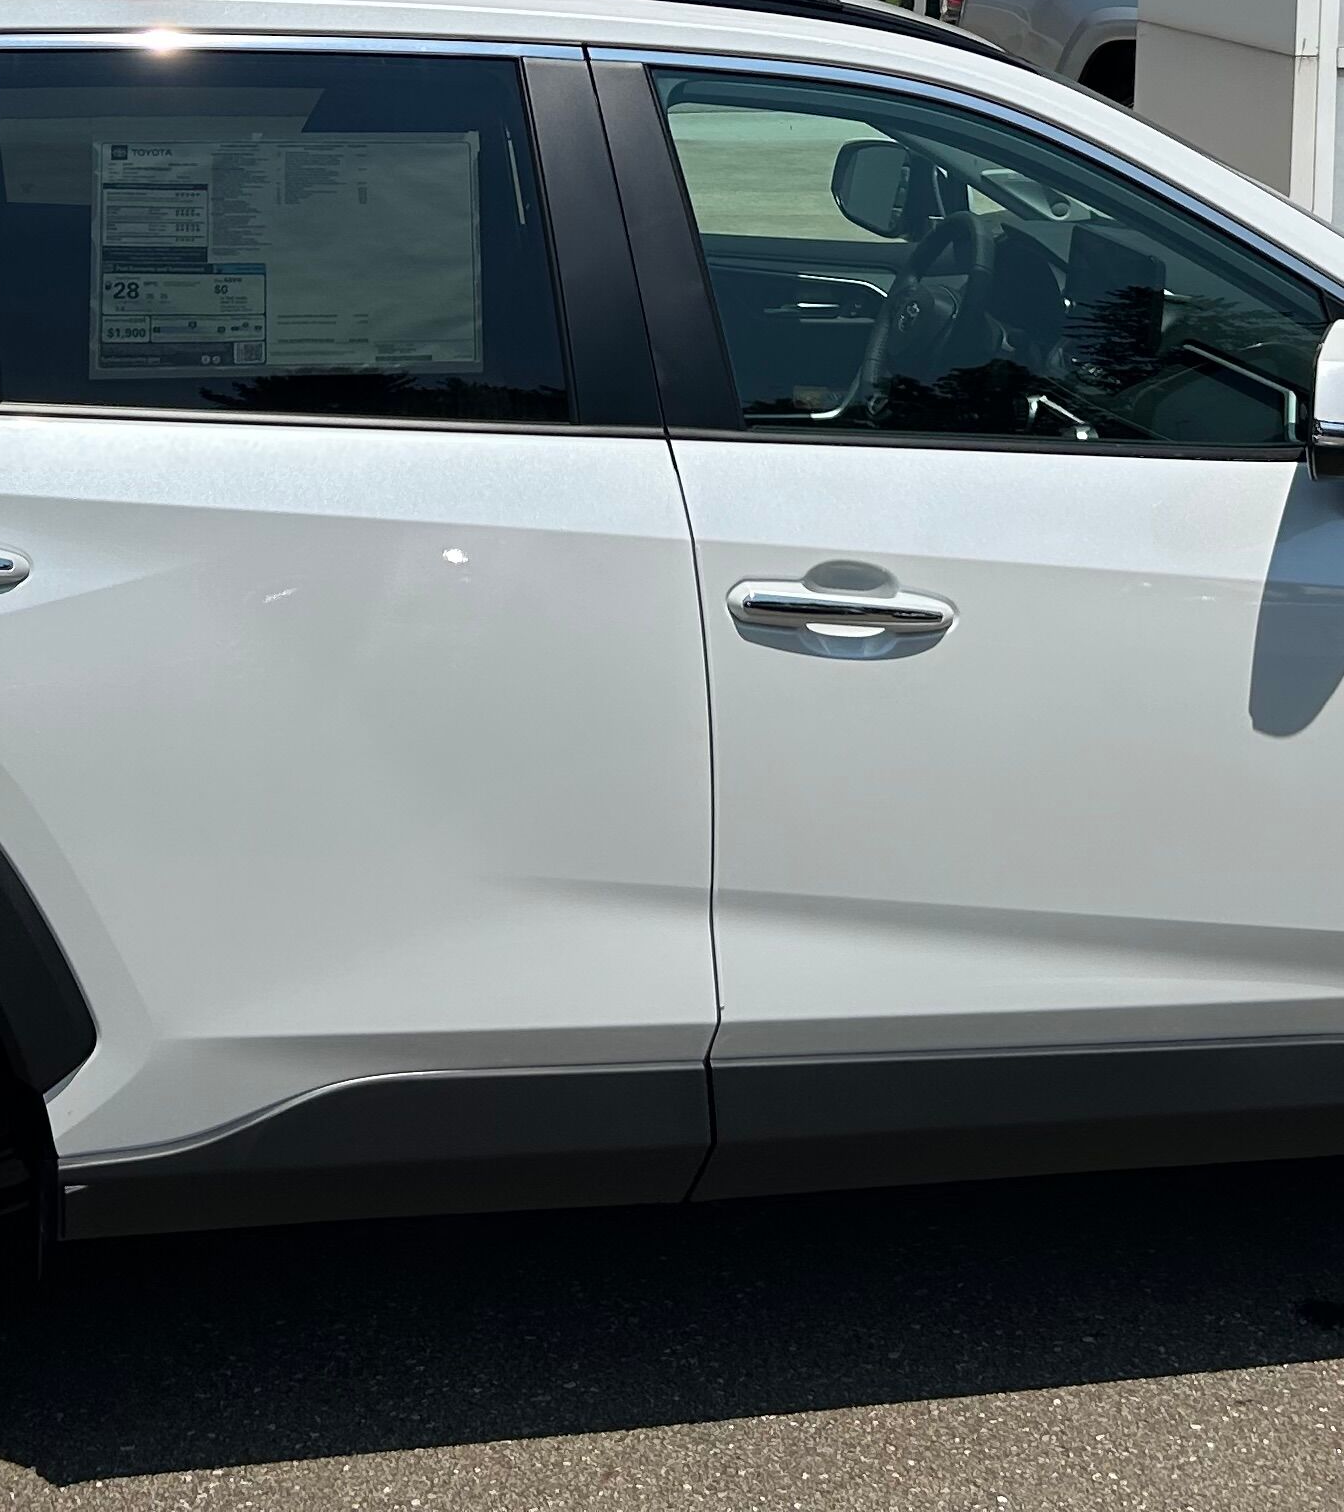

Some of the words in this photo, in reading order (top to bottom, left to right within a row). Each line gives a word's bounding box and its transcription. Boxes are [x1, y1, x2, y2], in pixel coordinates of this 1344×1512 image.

[131, 148, 173, 157] TOYOTA
[112, 281, 140, 300] 28
[106, 327, 147, 340] $1,900
